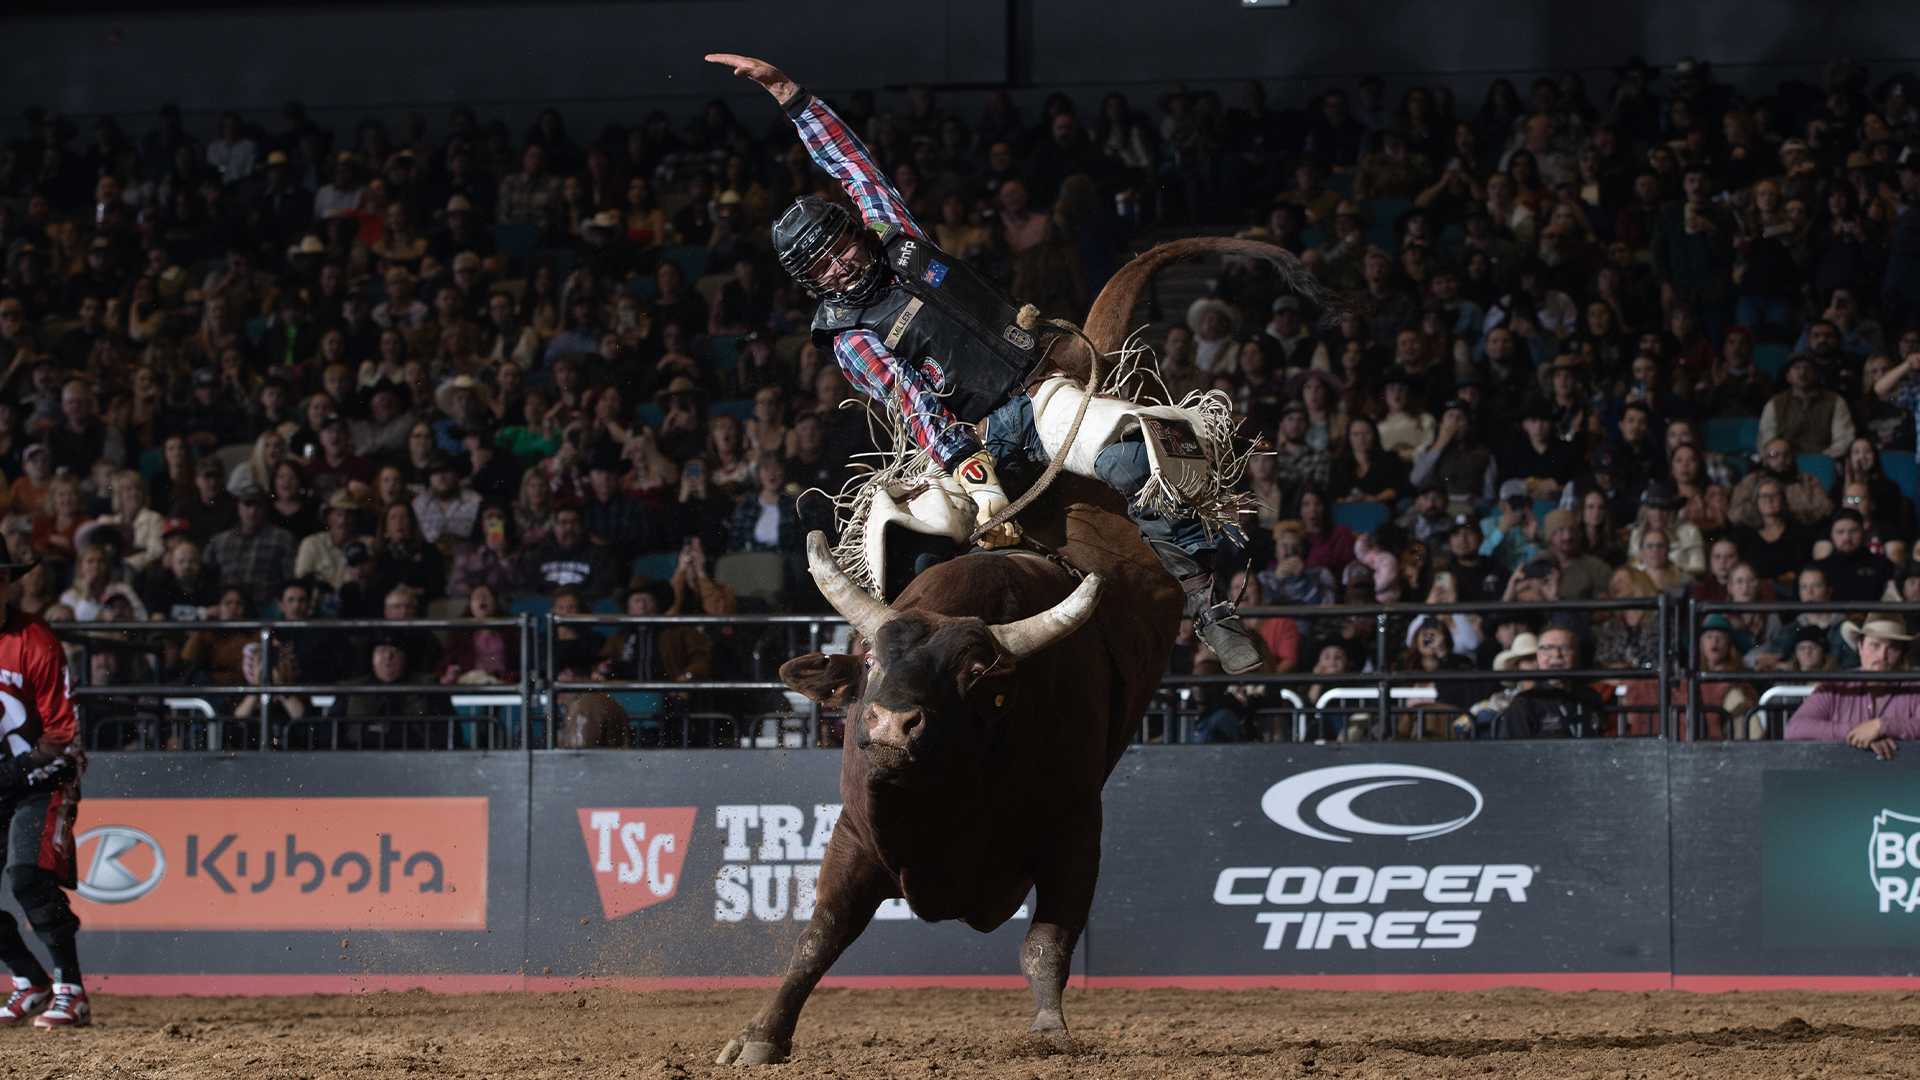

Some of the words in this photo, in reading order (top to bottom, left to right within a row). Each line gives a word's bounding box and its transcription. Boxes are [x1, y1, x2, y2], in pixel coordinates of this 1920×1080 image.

[898, 241, 916, 267] #nfp
[892, 311, 912, 338] MILLER
[185, 834, 443, 893] Kubota
[590, 811, 675, 898] TSC
[1213, 864, 1534, 905] COOPER
[1255, 910, 1482, 950] TIRES
